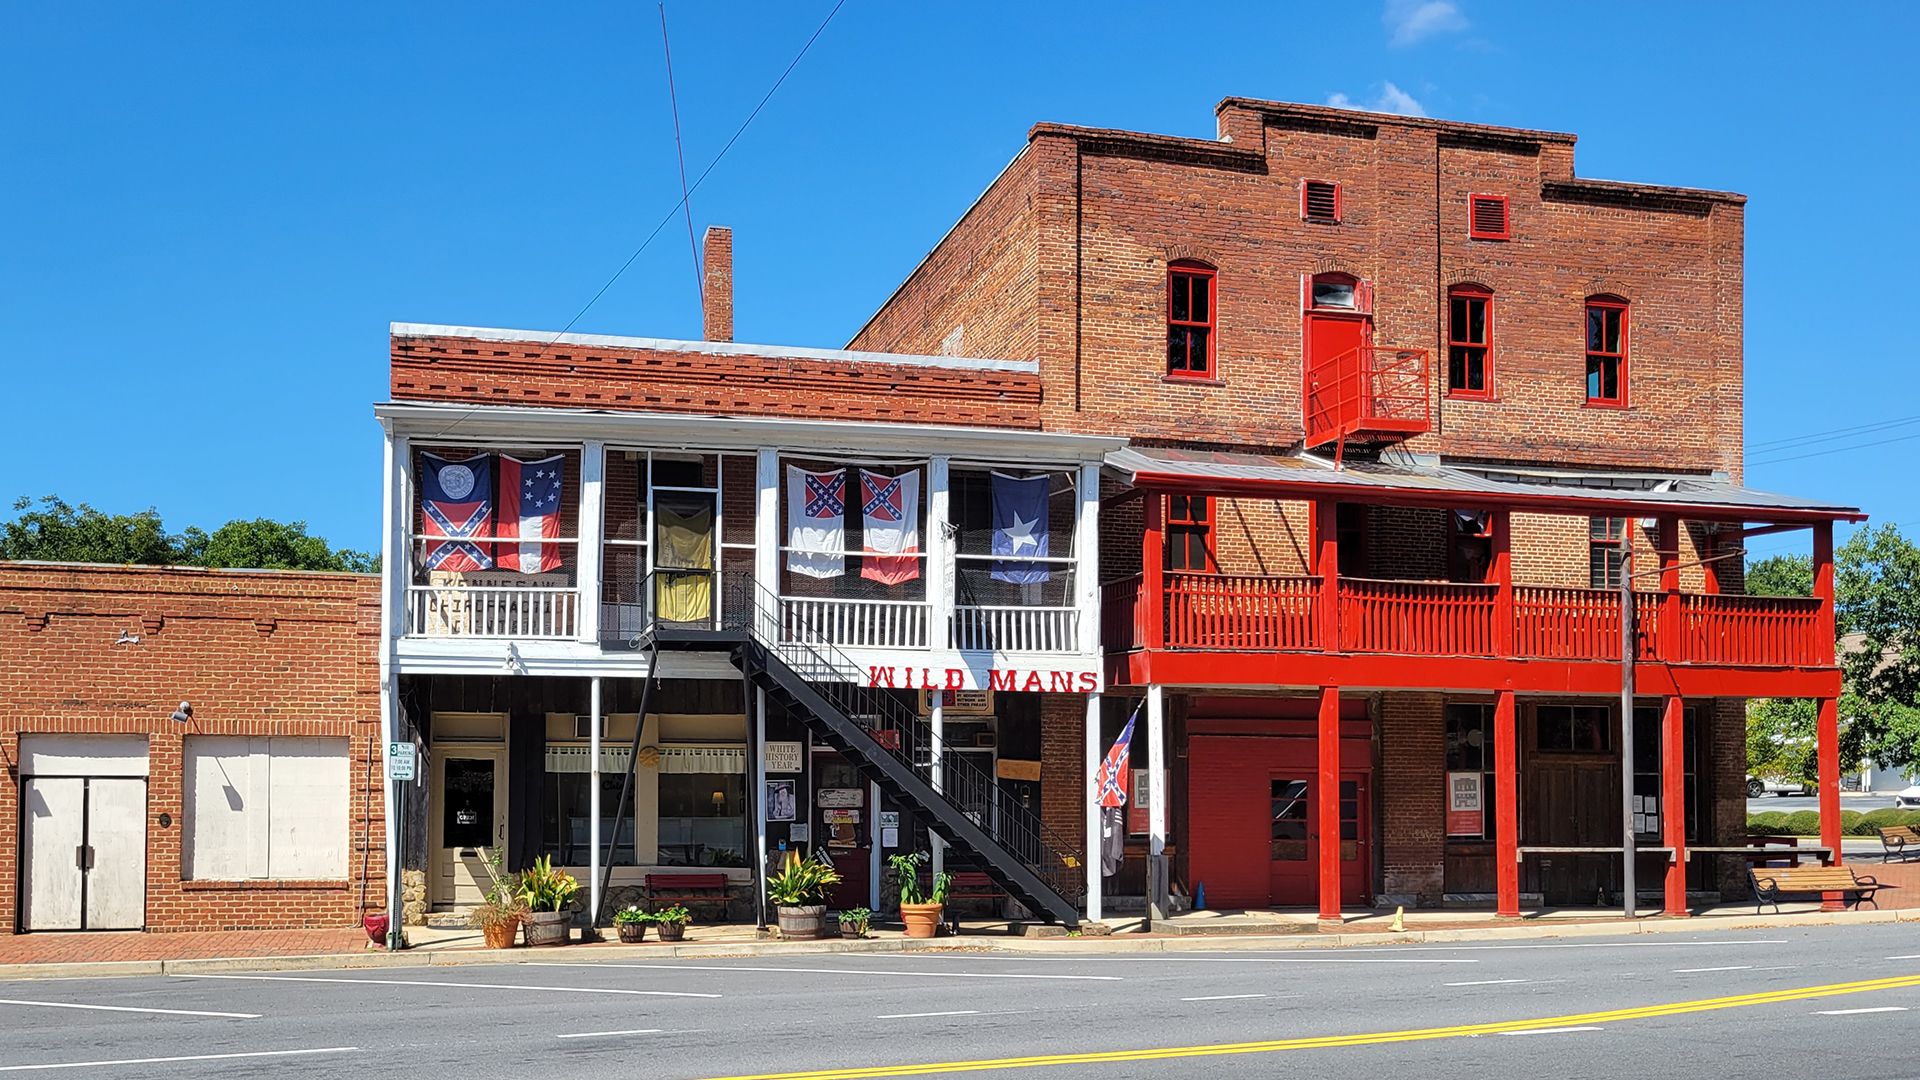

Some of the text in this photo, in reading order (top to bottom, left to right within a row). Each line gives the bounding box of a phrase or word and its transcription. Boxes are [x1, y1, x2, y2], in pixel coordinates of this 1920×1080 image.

[869, 666, 1097, 693] WILD MANS
[391, 745, 397, 755] 3
[769, 744, 796, 753] WHITE
[765, 753, 799, 761] HISTORY
[771, 761, 793, 769] YEAR
